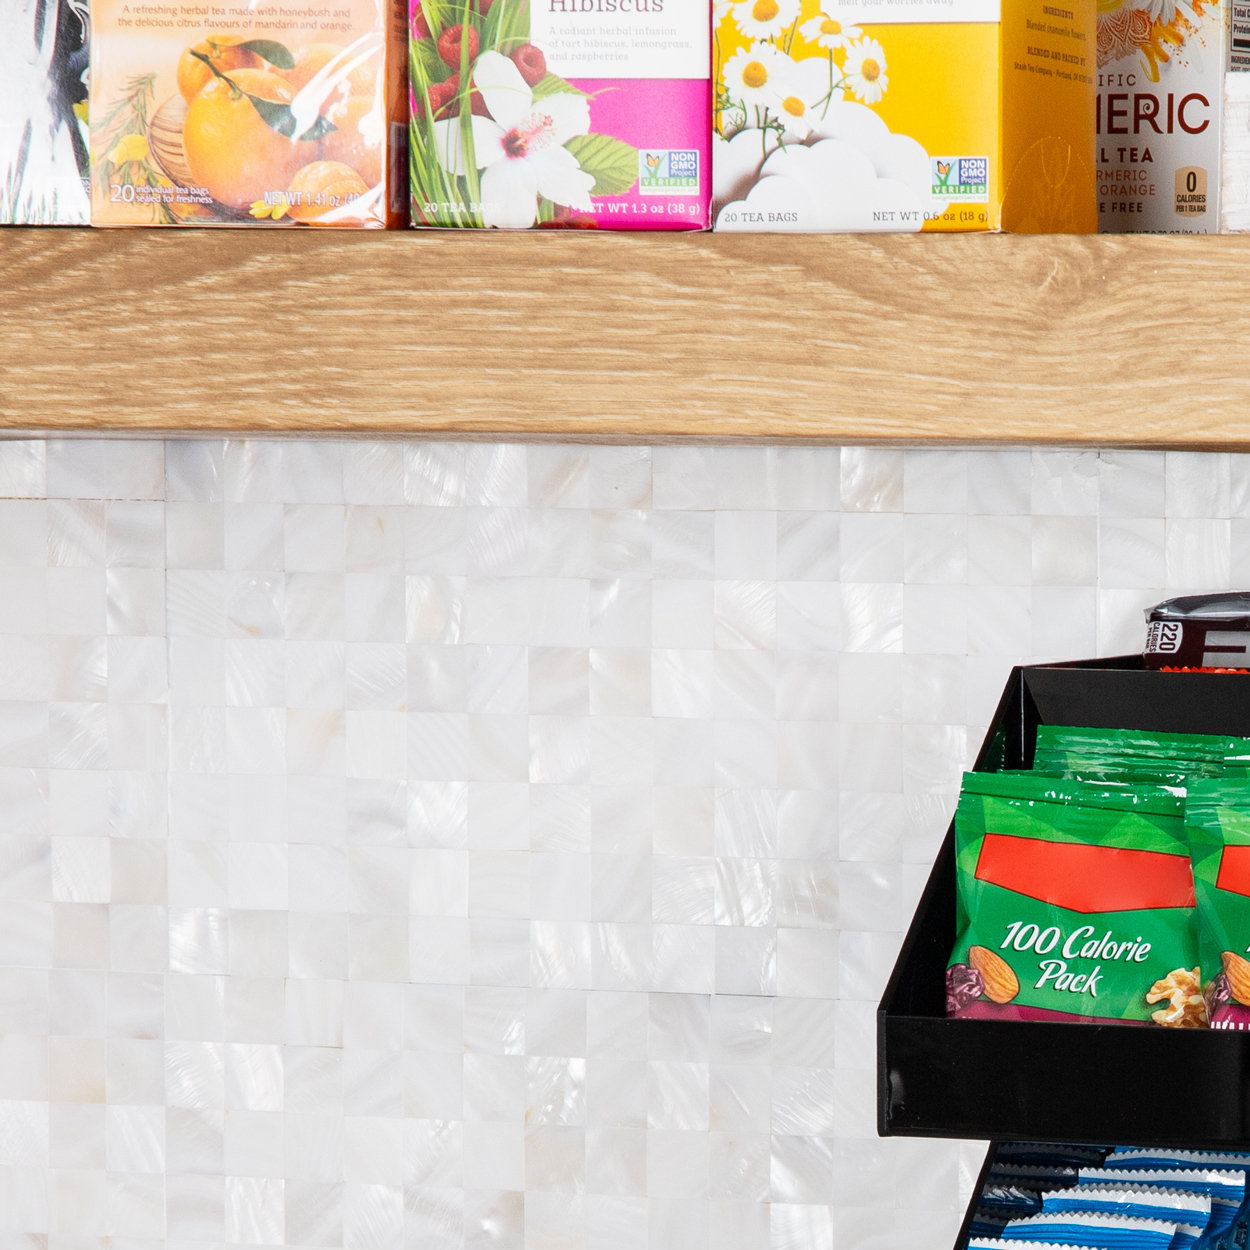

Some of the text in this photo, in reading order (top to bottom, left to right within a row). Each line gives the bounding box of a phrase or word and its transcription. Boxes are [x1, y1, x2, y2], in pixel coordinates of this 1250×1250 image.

[122, 5, 350, 18] A refreshing herbal tea made with honeybush and
[1043, 5, 1074, 20] INGREDIENTS
[1234, 7, 1246, 17] Total
[118, 17, 352, 32] the delicious citrus flavours of mandarin and orange
[1233, 23, 1250, 34] Protein
[549, 26, 677, 36] A radiant herbal infusion
[549, 39, 693, 51] of tart hibiscus, lemongrass,
[549, 52, 629, 63] and raspberries
[1027, 45, 1050, 59] BLENDED
[1051, 50, 1061, 61] AND
[1062, 53, 1079, 66] PACKED
[671, 152, 695, 161] NON
[1117, 147, 1154, 163] TEA
[670, 161, 697, 170] GMO
[961, 159, 985, 169] NON
[671, 170, 695, 178] Project
[960, 168, 986, 178] GMO
[643, 178, 697, 186] VERIFIED
[961, 177, 985, 185] Project
[1186, 171, 1197, 193] 0
[110, 184, 135, 202] 20
[136, 185, 209, 196] individual tea bags
[934, 186, 986, 194] VERIFIED
[1100, 184, 1156, 197] ORANGE
[136, 194, 213, 204] sealed for freshness
[264, 191, 341, 207] NET WT 1.41 oz
[1176, 194, 1207, 203] CALORIES
[424, 202, 467, 213] 20 TEA
[579, 203, 701, 216] NET WT 1.3 oz (38 g)
[1111, 202, 1143, 213] FREE
[1175, 204, 1207, 213] PER TEA BAG
[724, 212, 798, 223] 20 TEA BAGS
[873, 210, 989, 223] NET WT 0.6 oz (18 g)
[1149, 621, 1160, 654] CALORIES
[1158, 622, 1179, 652] 220
[1000, 920, 1152, 963] 100 Calorie
[1034, 960, 1104, 997] Pack
